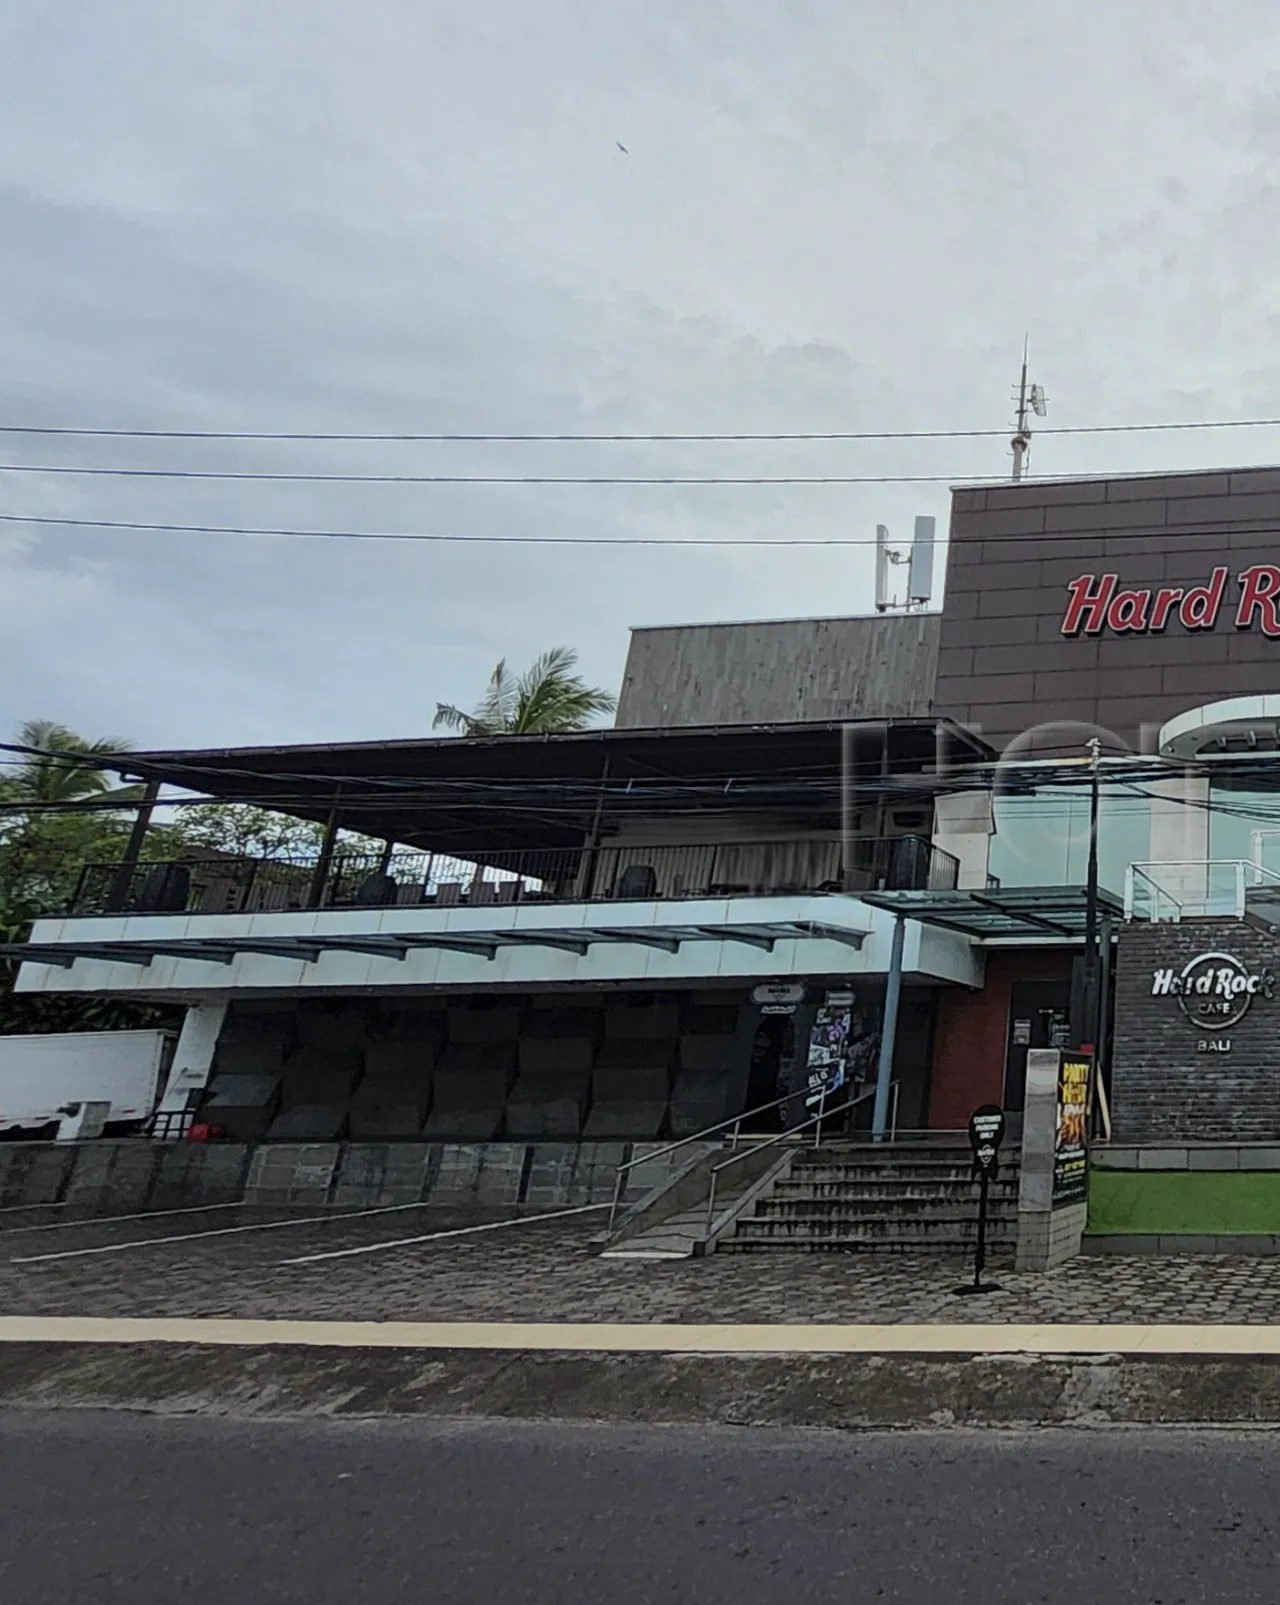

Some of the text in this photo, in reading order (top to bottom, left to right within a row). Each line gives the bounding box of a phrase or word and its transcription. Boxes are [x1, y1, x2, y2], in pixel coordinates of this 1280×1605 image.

[1061, 566, 1228, 634] Hard
[1152, 967, 1275, 1000] Hard Rock
[1199, 1002, 1230, 1015] CAFE
[1198, 1039, 1231, 1052] BALI
